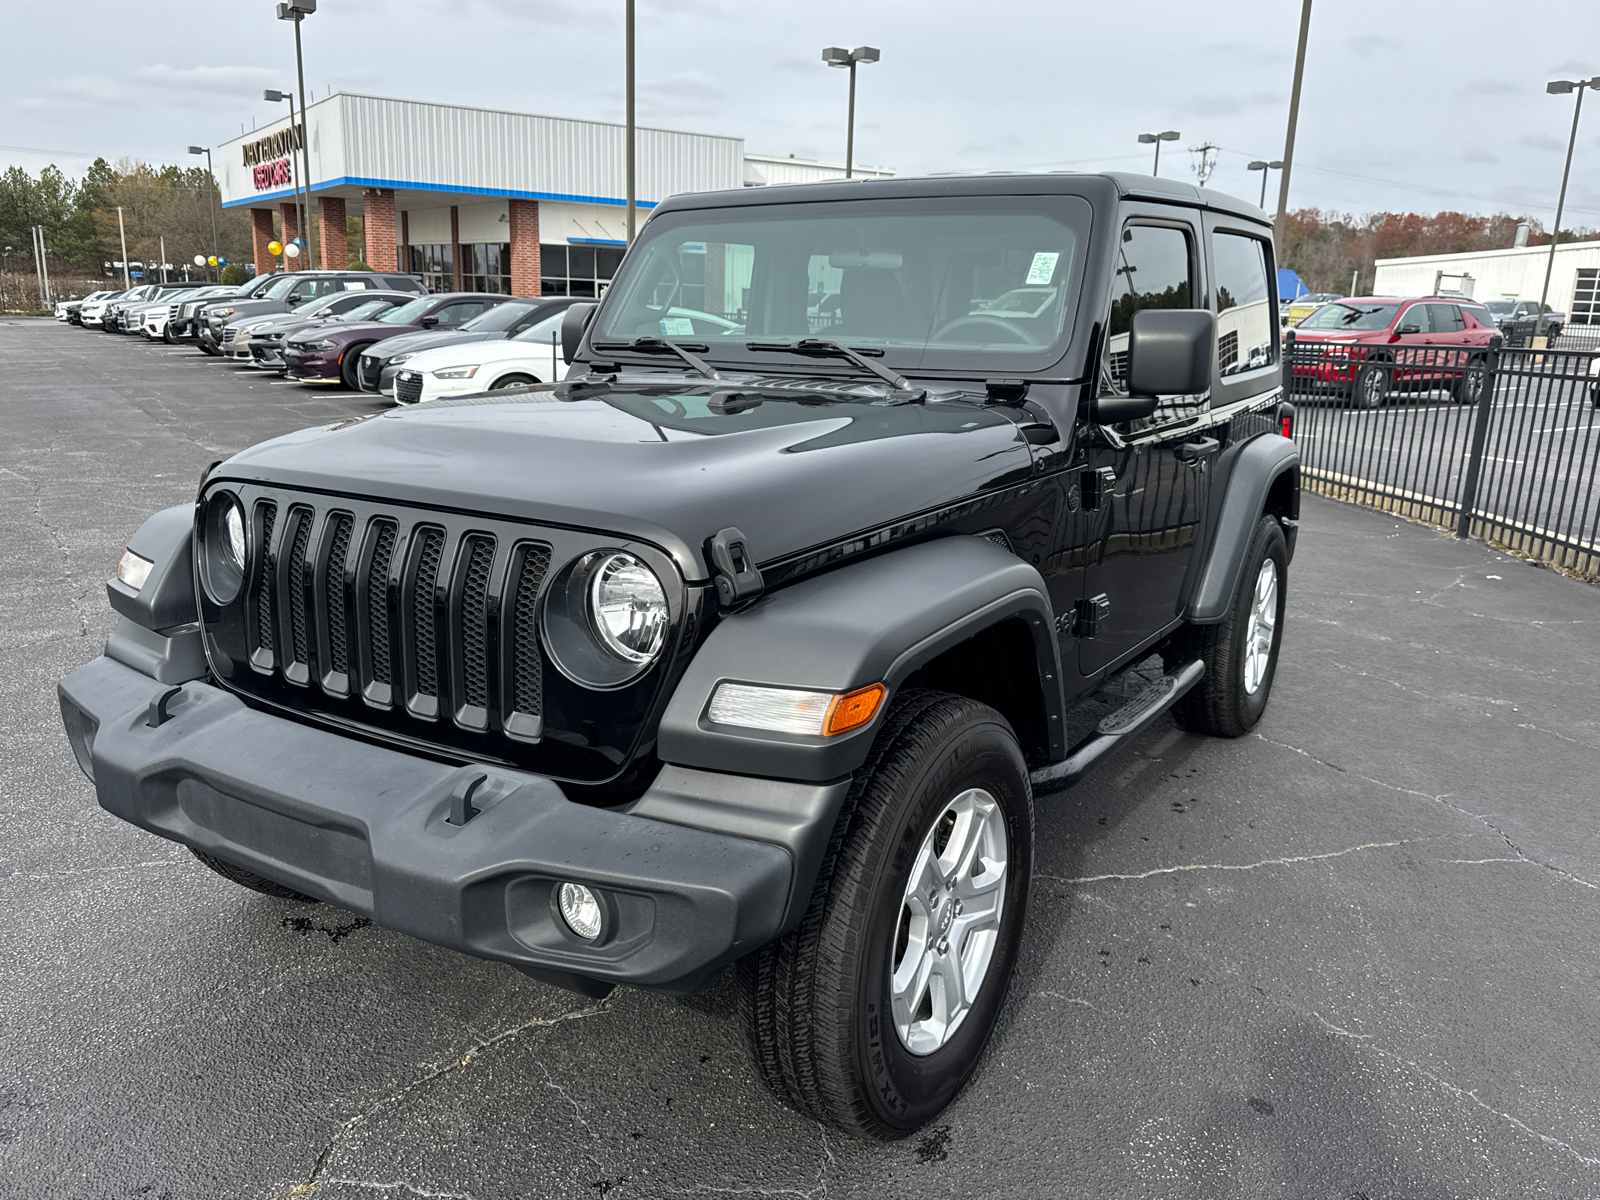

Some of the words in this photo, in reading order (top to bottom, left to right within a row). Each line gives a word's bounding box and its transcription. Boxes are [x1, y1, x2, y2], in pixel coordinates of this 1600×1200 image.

[253, 165, 270, 189] USED
[270, 158, 290, 186] CARS
[1054, 608, 1078, 636] eep
[881, 1080, 908, 1116] LTX
